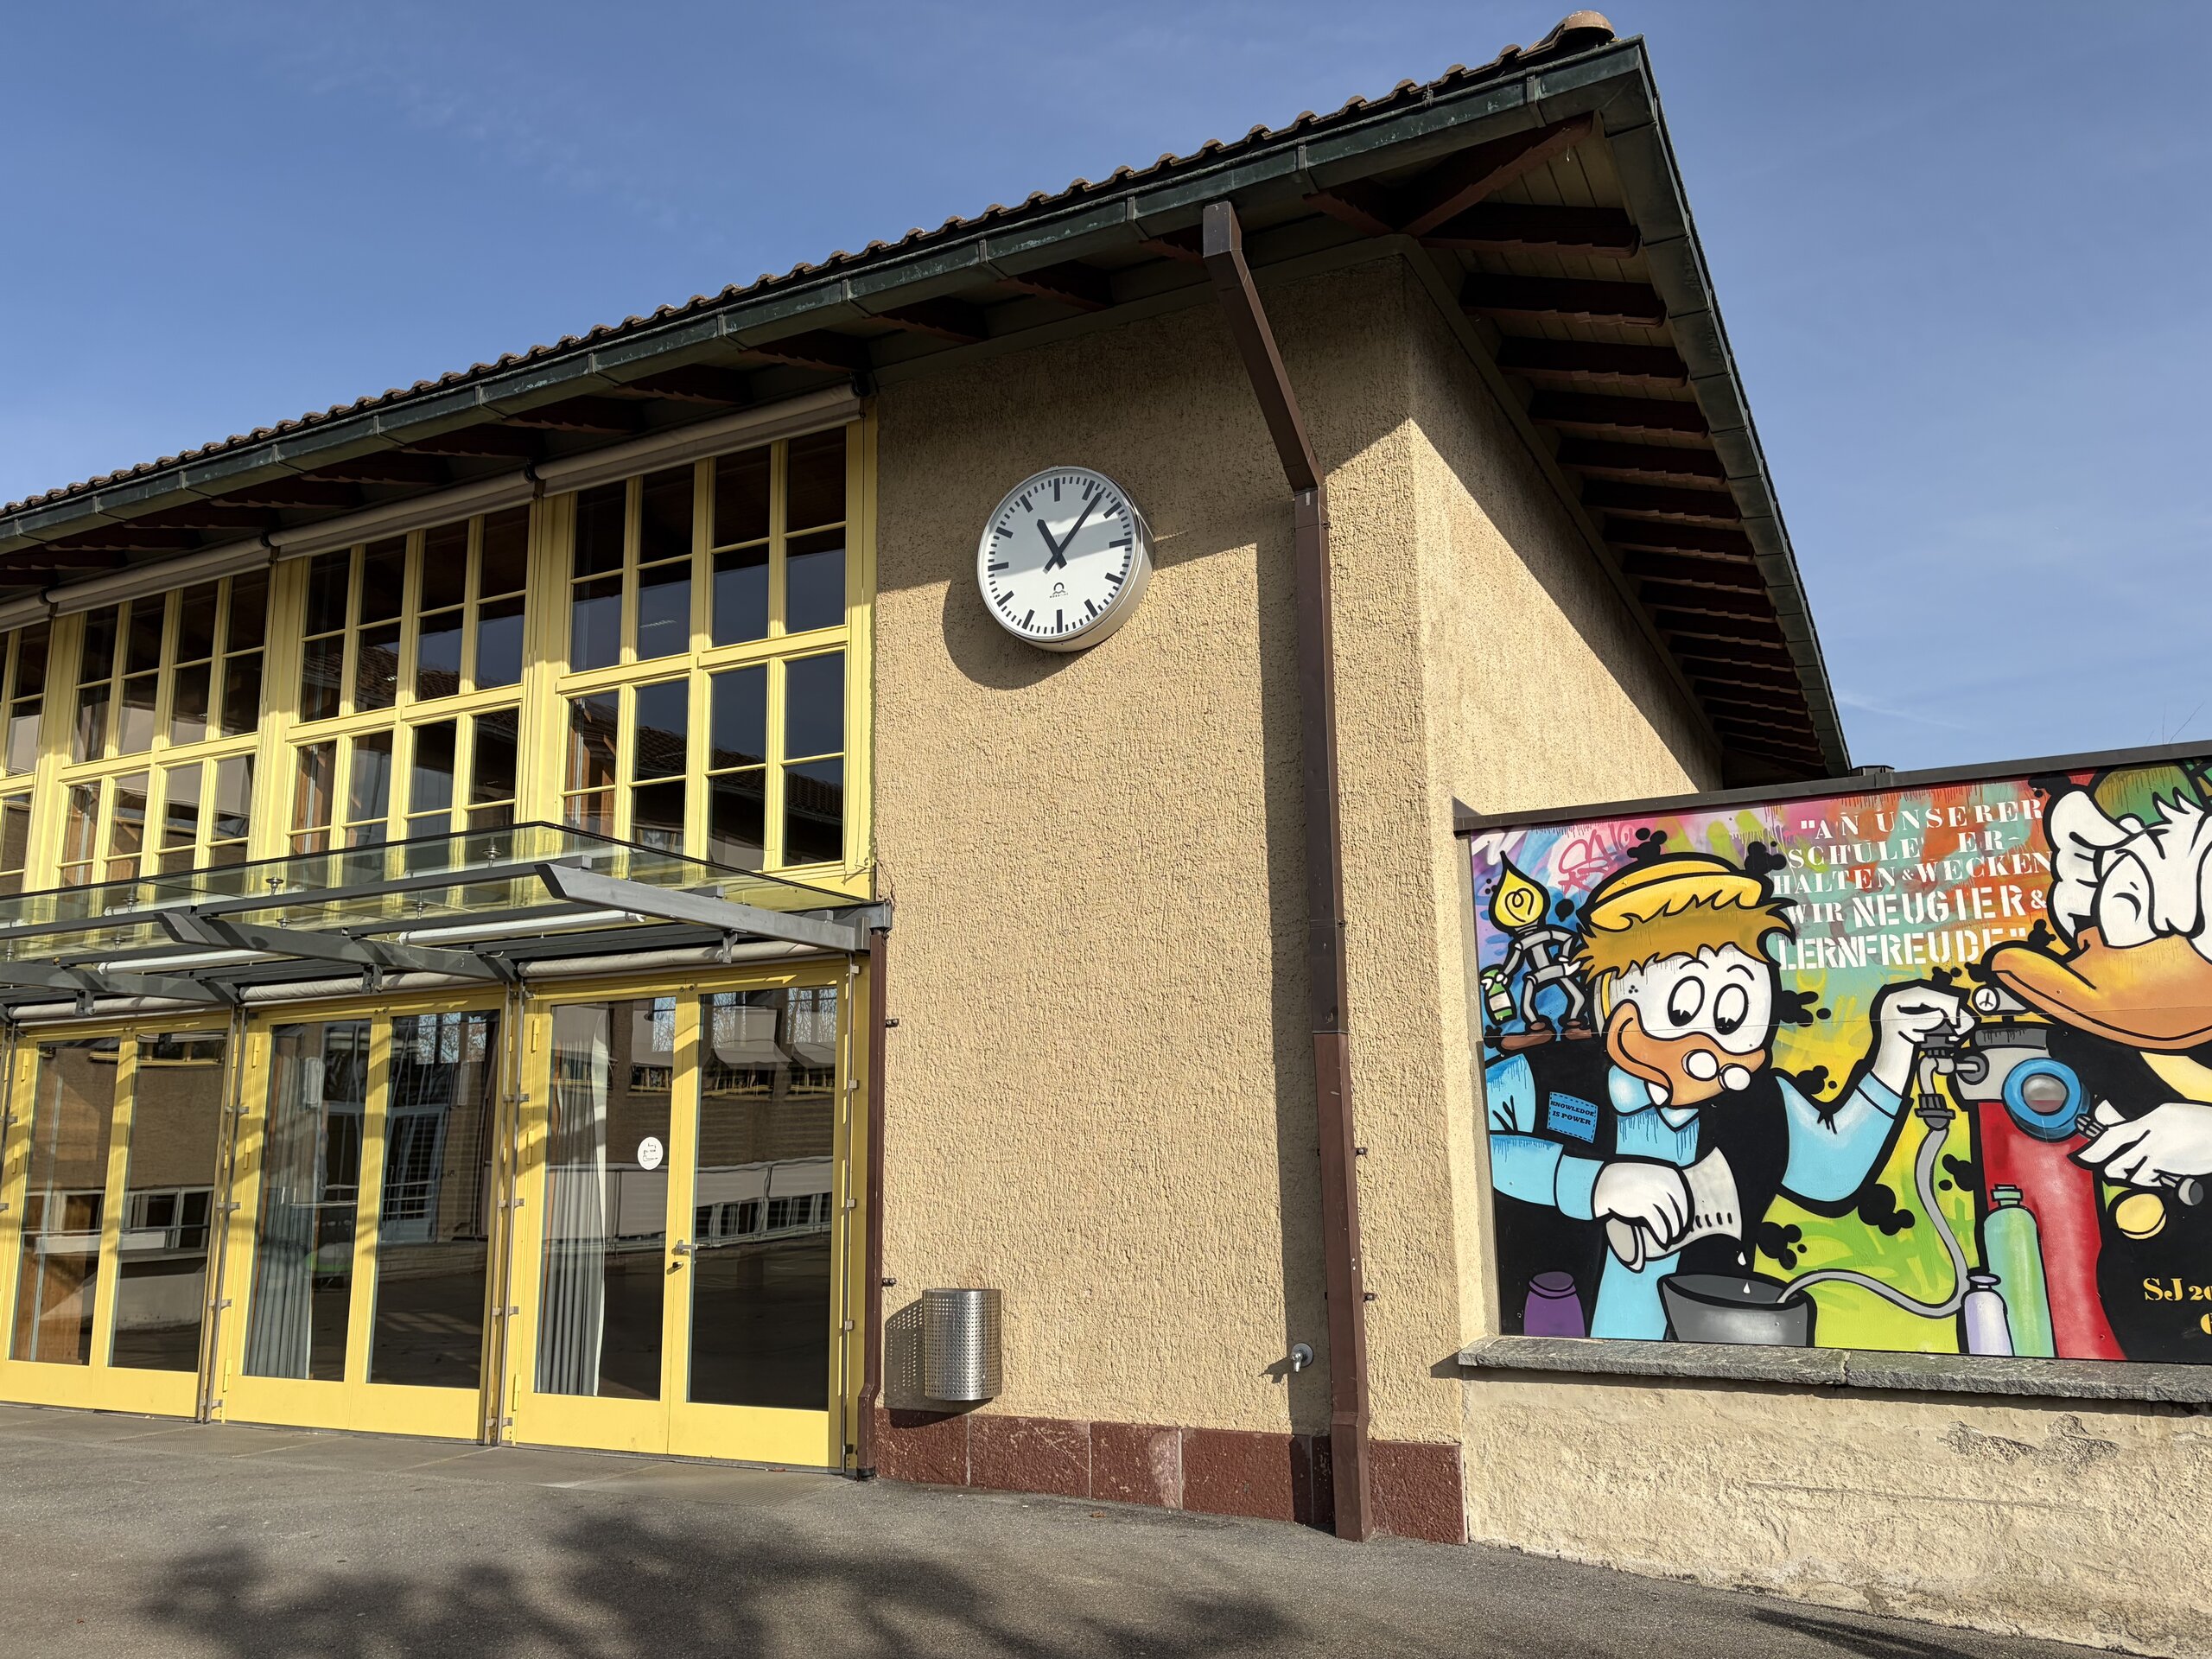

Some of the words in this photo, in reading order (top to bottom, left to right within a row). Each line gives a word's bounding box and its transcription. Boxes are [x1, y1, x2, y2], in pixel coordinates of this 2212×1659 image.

[1875, 799, 2043, 832] UNSERER
[1788, 837, 1923, 868] SCHULE
[1958, 830, 2020, 853] ER-
[1772, 867, 1895, 894] HALTEN
[1787, 902, 1844, 924] WIR
[1852, 885, 2026, 928] NEUGIER
[2031, 889, 2047, 910] &
[1550, 1100, 1594, 1116] KNOWLEDGE
[1561, 1113, 1591, 1125] POWER
